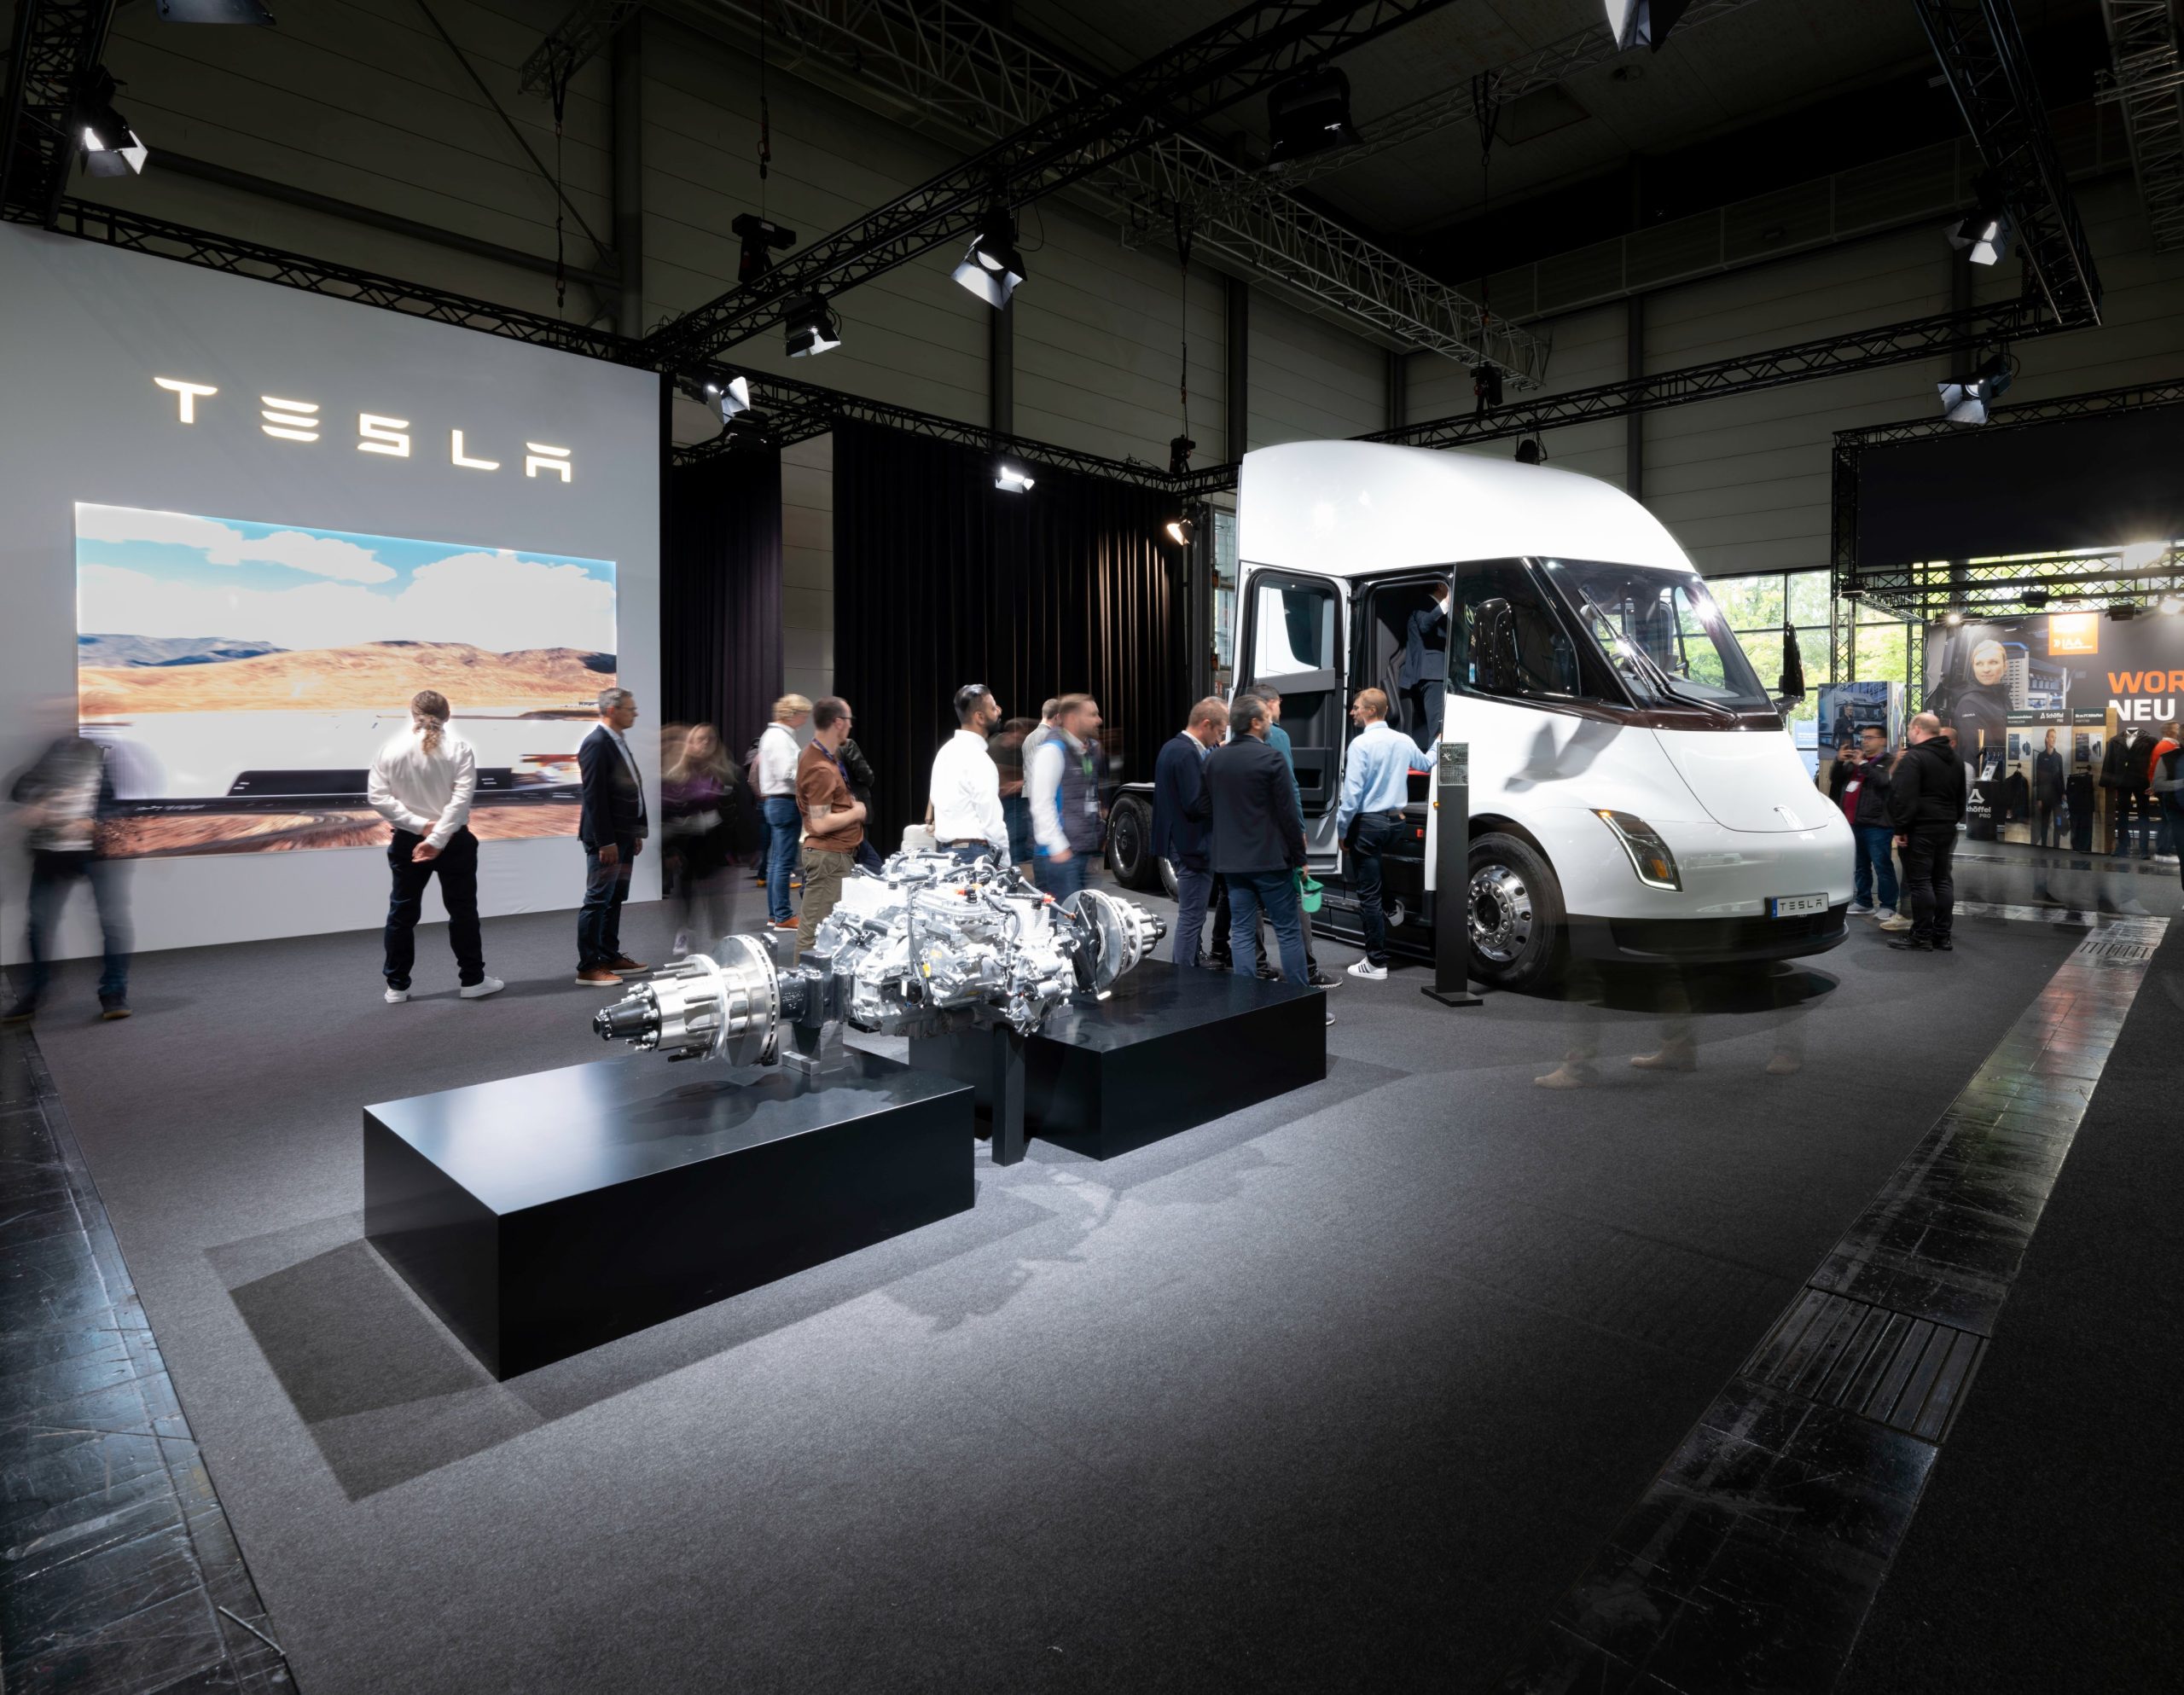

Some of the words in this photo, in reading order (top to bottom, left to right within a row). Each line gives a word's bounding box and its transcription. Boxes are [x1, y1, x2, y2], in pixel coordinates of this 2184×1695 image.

[154, 377, 572, 483] TESLA
[2107, 670, 2184, 694] WOR
[2109, 699, 2175, 721] NEU
[1780, 899, 1822, 911] TESLA
